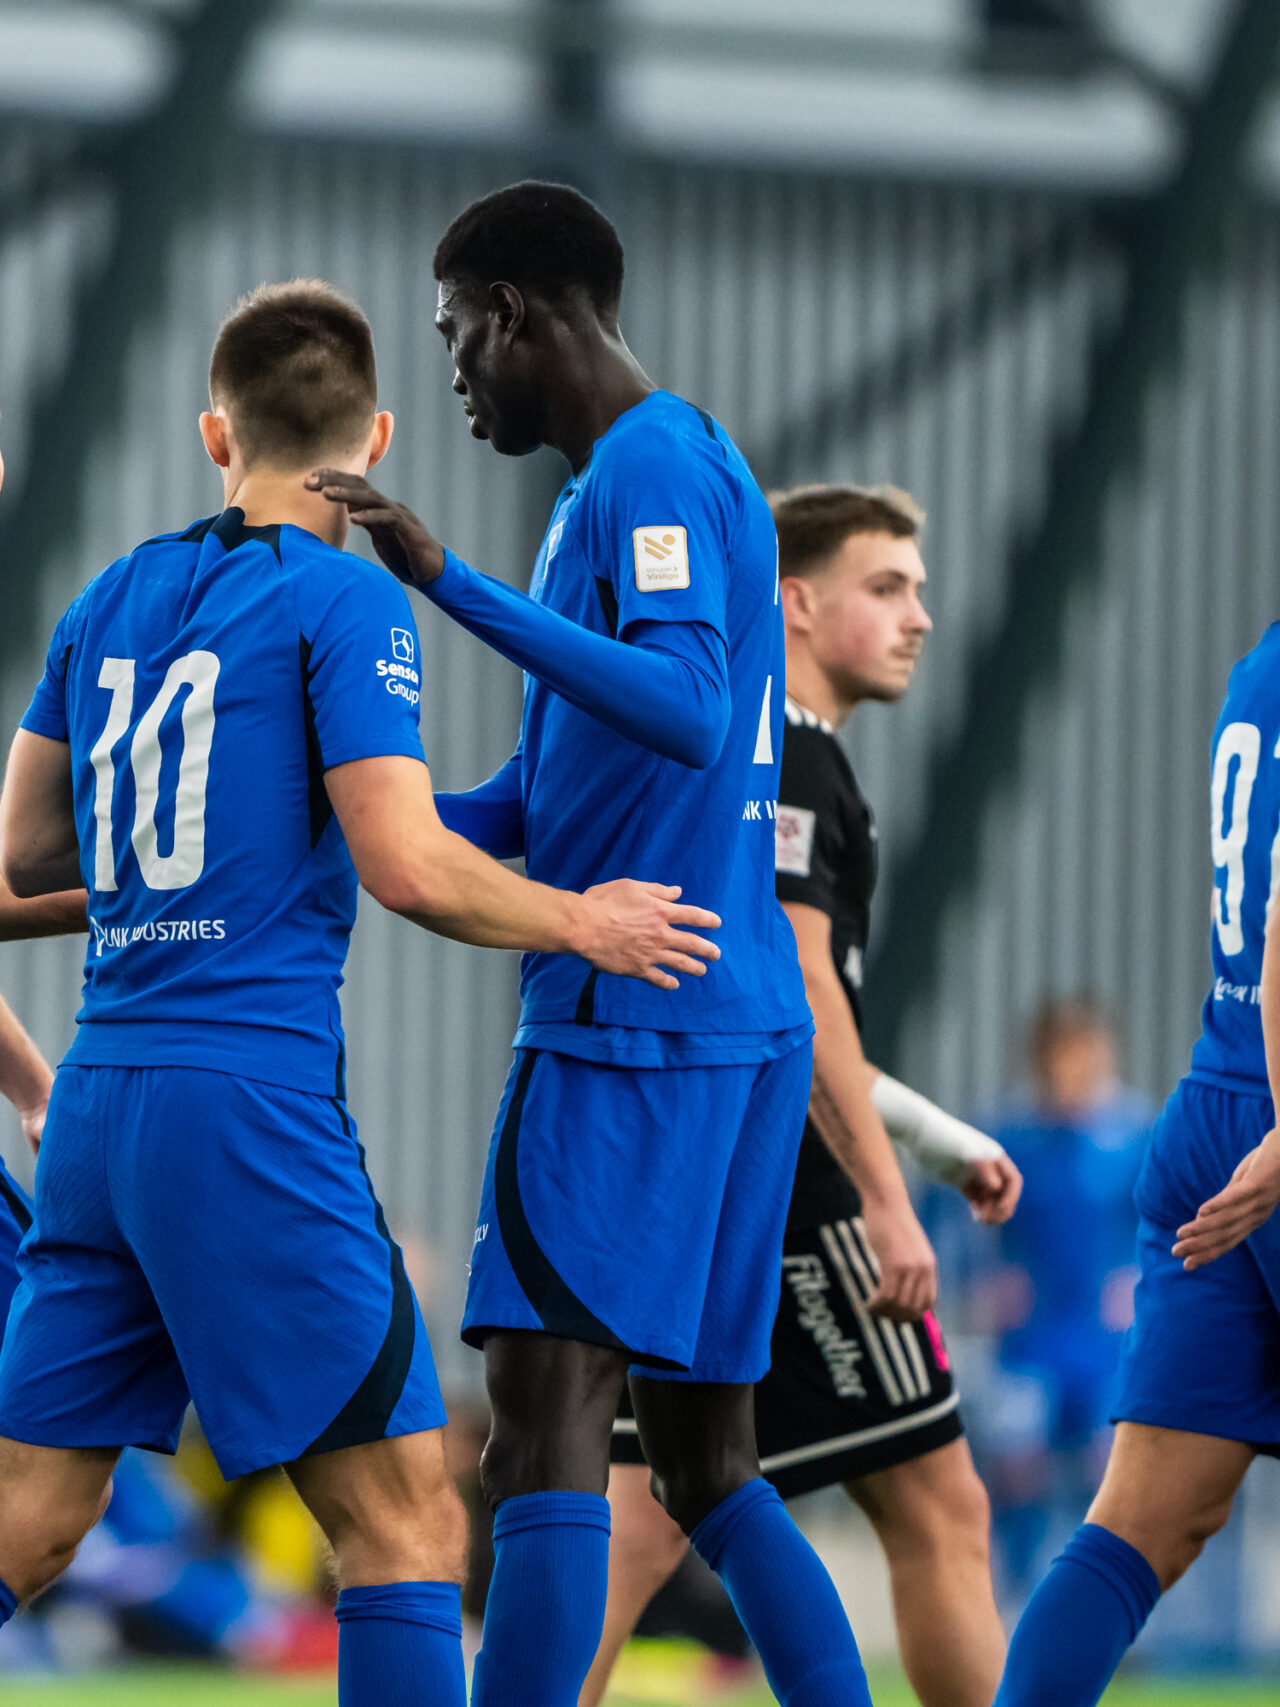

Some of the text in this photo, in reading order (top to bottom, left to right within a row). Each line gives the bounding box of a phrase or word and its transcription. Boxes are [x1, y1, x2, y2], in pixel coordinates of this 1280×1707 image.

[90, 650, 220, 891] 10
[386, 677, 419, 707] Group
[1212, 722, 1280, 956] 9
